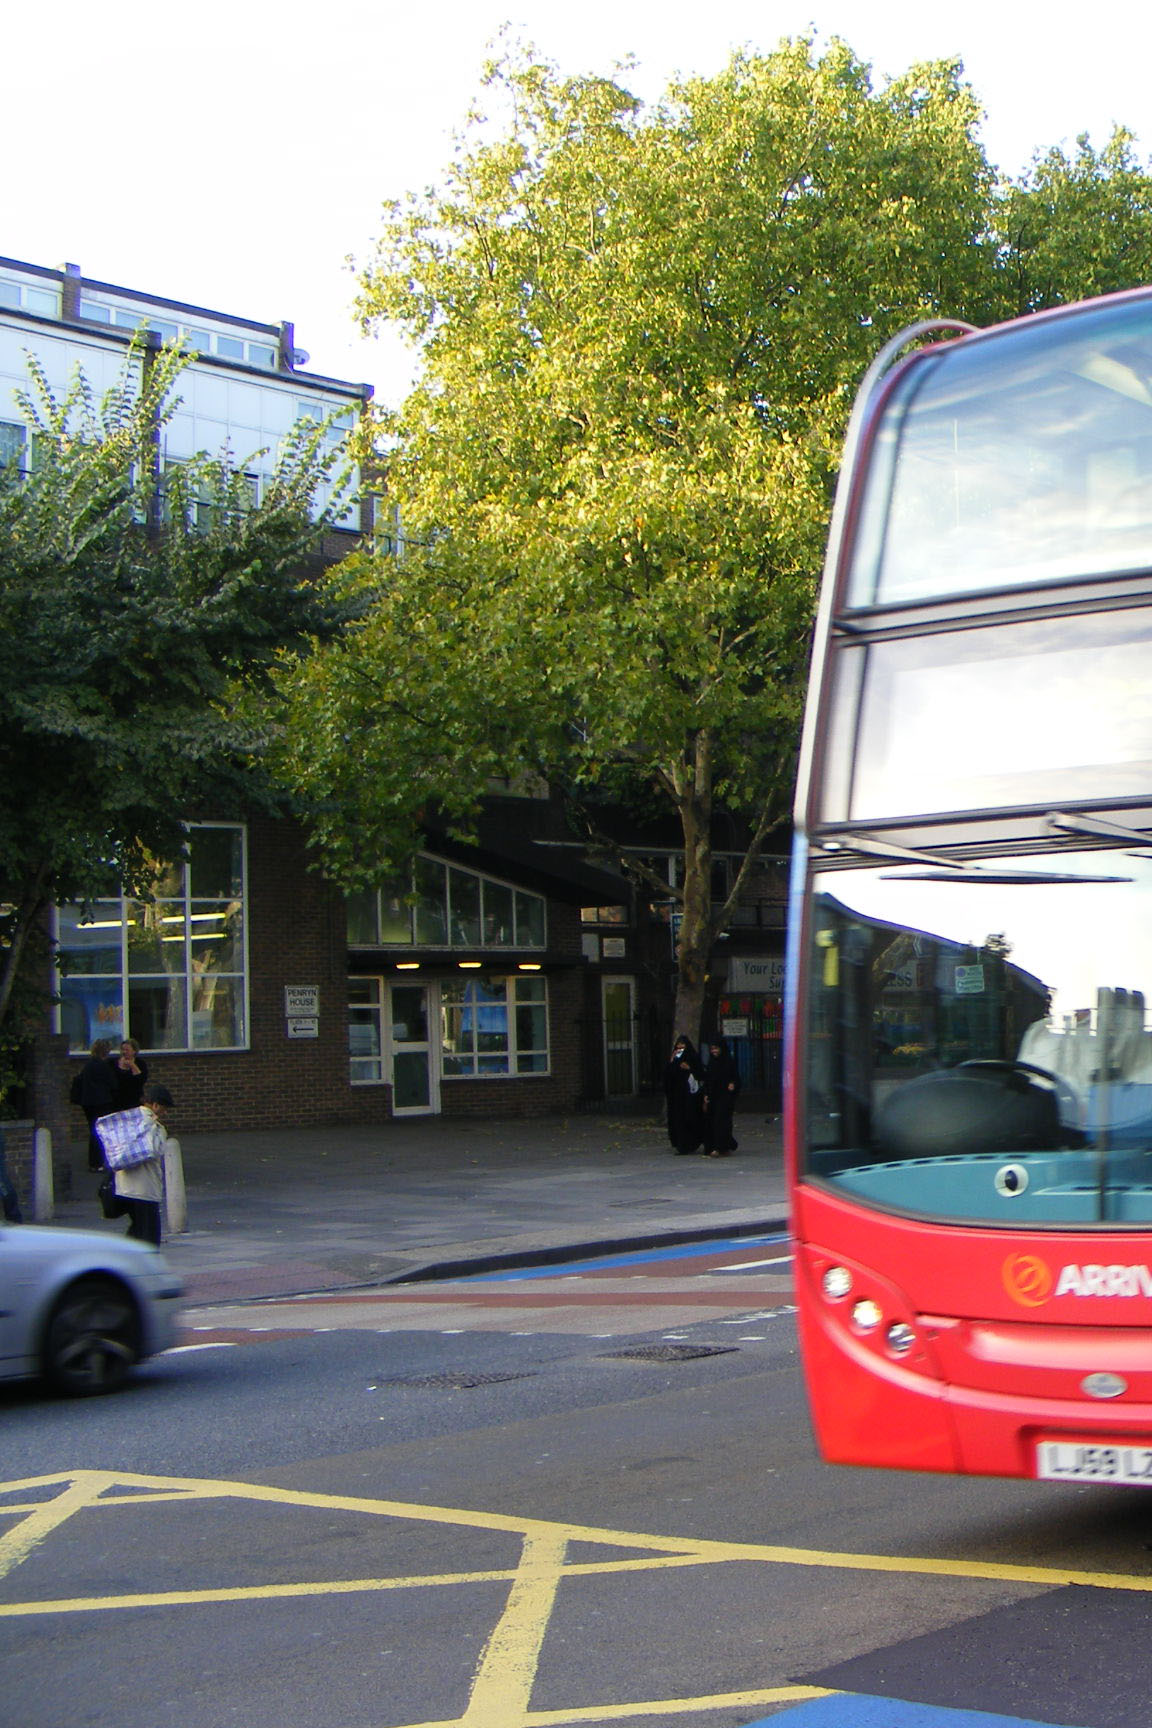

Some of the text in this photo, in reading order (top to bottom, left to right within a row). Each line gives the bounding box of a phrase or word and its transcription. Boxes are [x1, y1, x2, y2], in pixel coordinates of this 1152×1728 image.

[744, 961, 769, 975] Your
[287, 989, 317, 997] PENRYN
[289, 998, 315, 1007] HOUSE
